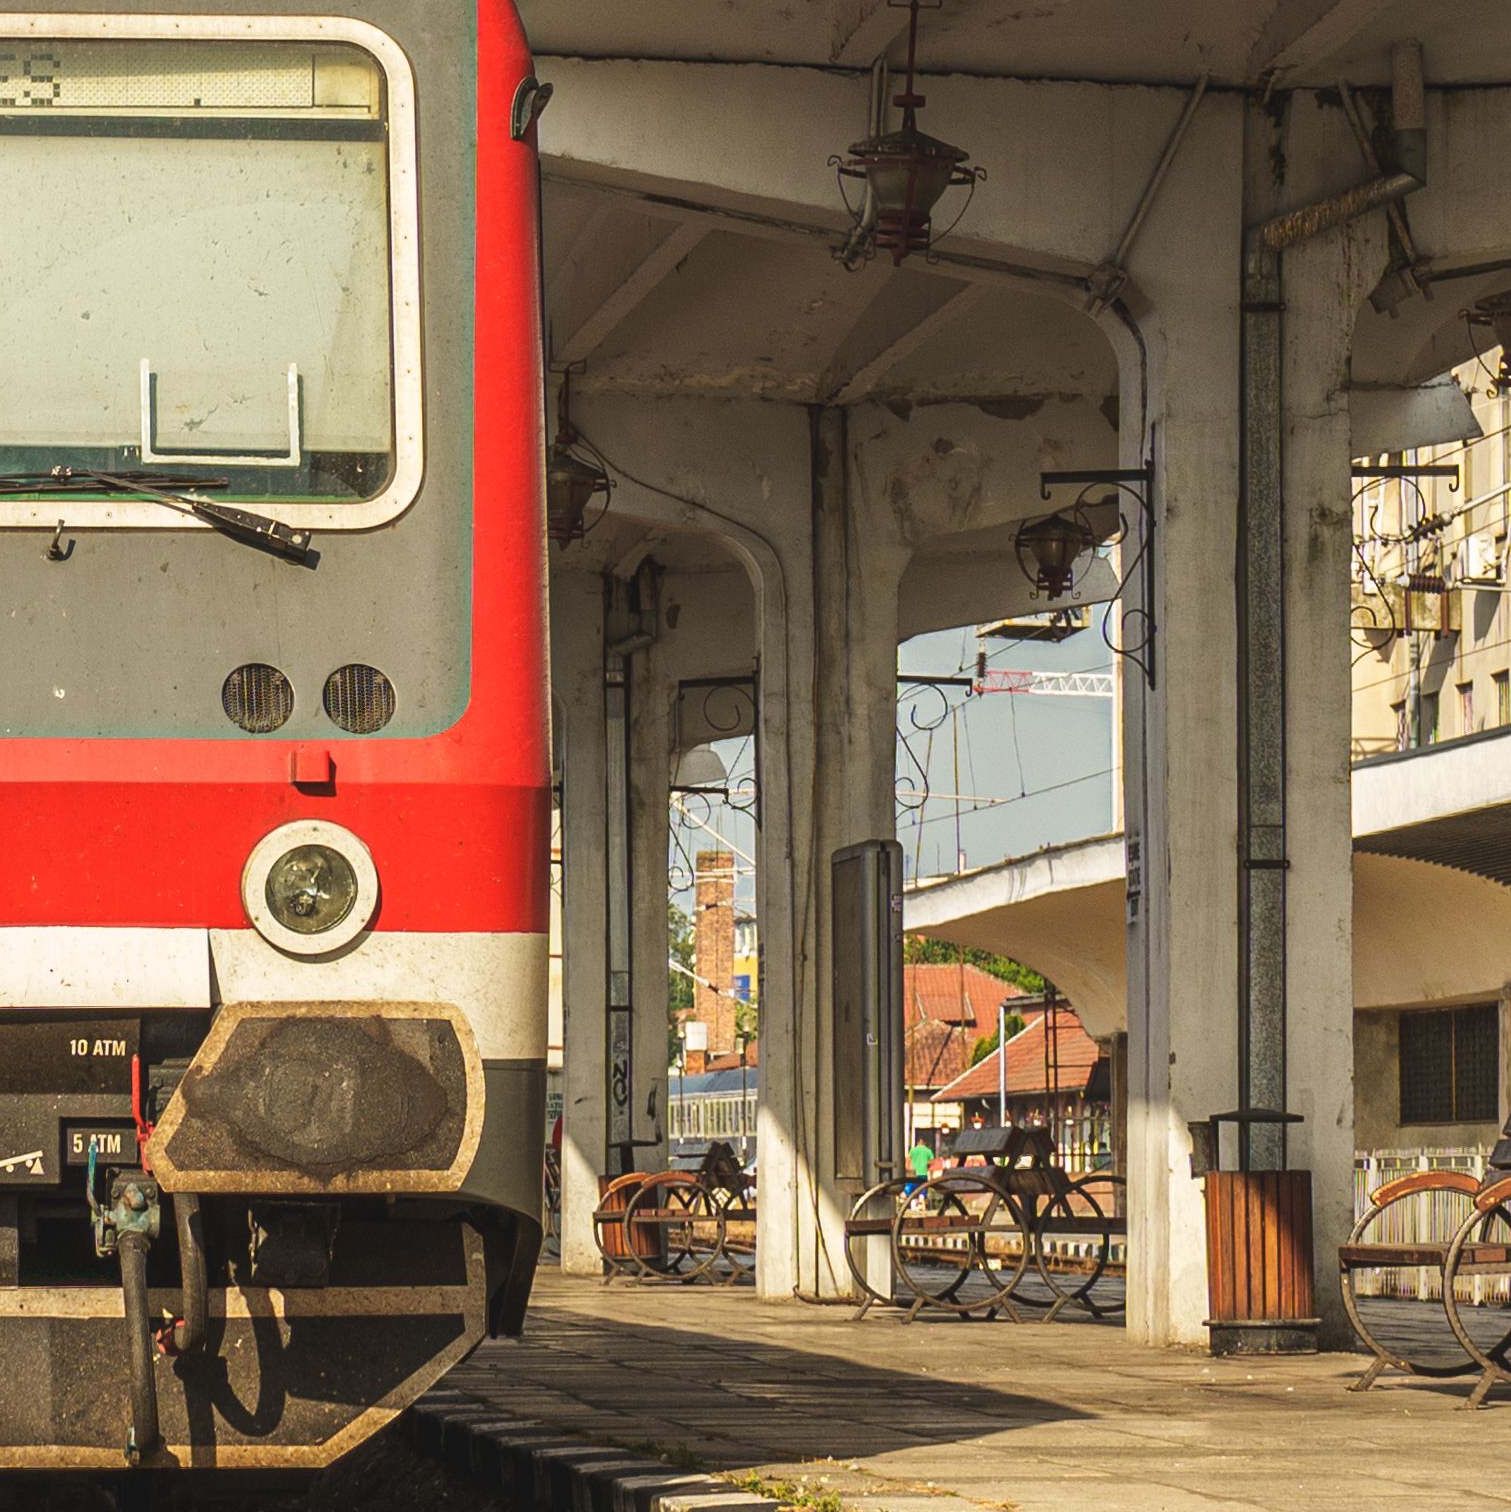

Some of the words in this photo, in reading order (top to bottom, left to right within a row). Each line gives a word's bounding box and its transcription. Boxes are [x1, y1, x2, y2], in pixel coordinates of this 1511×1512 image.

[70, 1039, 88, 1056] 10
[92, 1039, 126, 1056] ATM
[73, 1133, 83, 1154] 5
